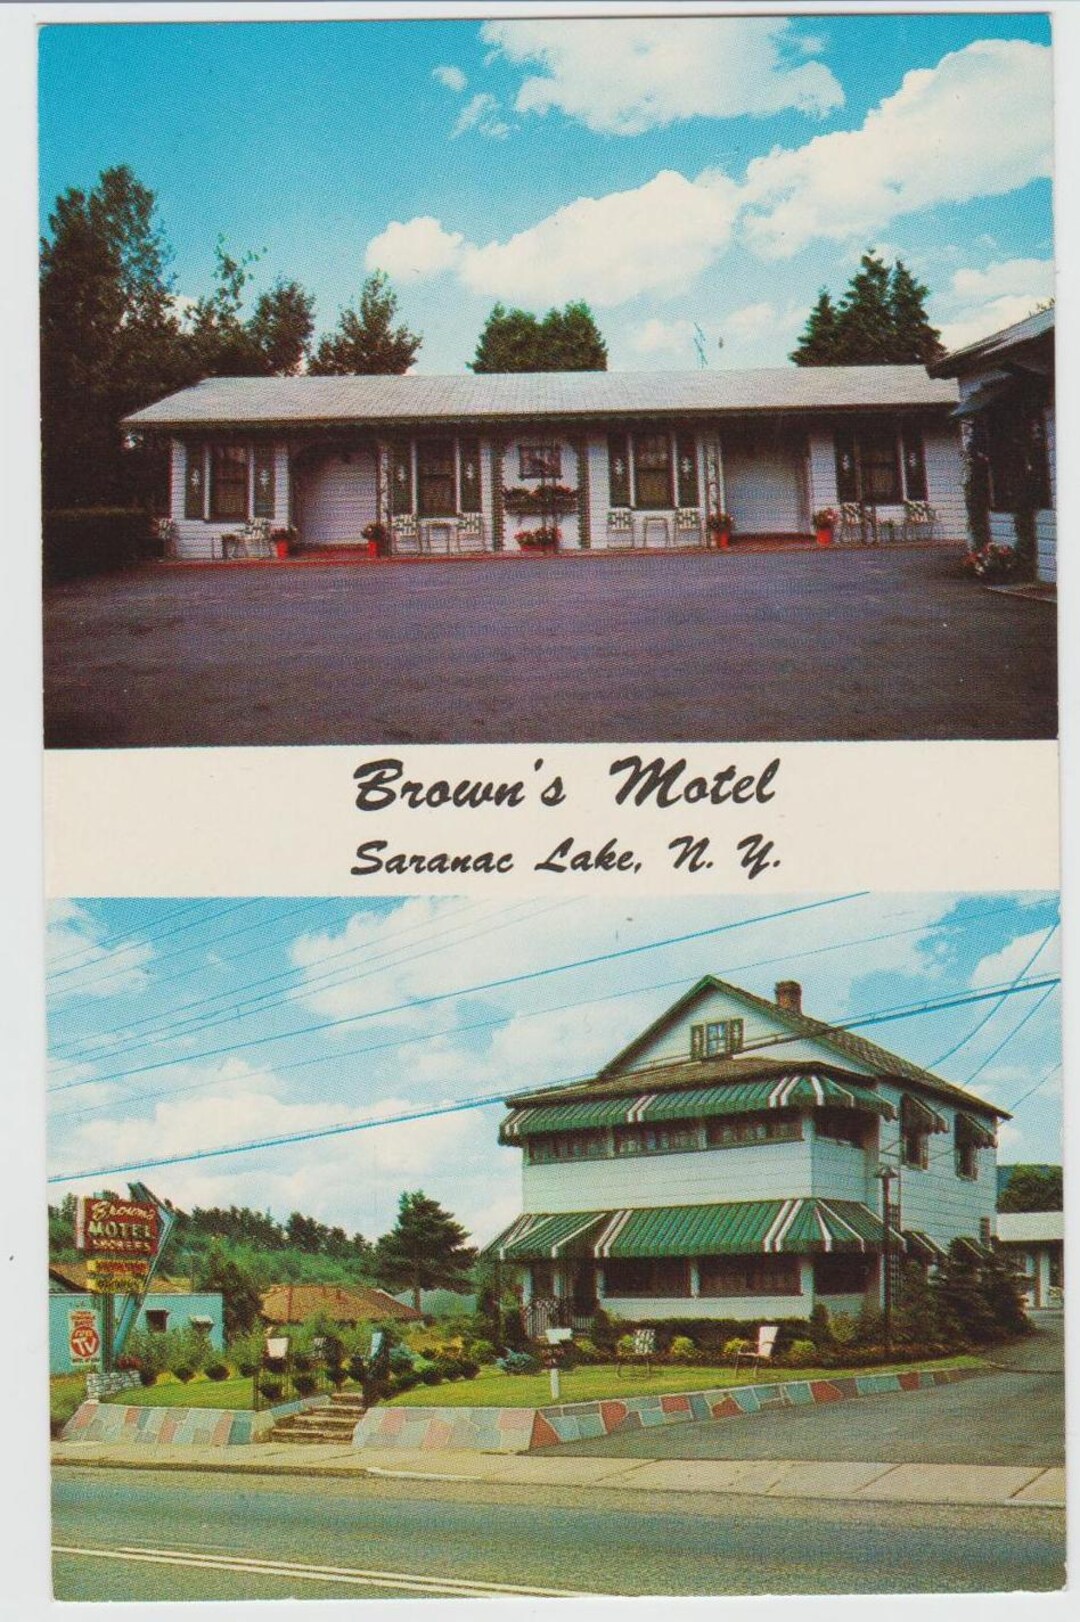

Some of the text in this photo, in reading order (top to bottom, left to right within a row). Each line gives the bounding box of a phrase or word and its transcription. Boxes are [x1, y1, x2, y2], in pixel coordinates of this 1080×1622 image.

[353, 755, 781, 812] Brown's Motel
[350, 840, 514, 876] Saranac
[534, 837, 642, 874] Lake,
[89, 1221, 152, 1238] MOTEL
